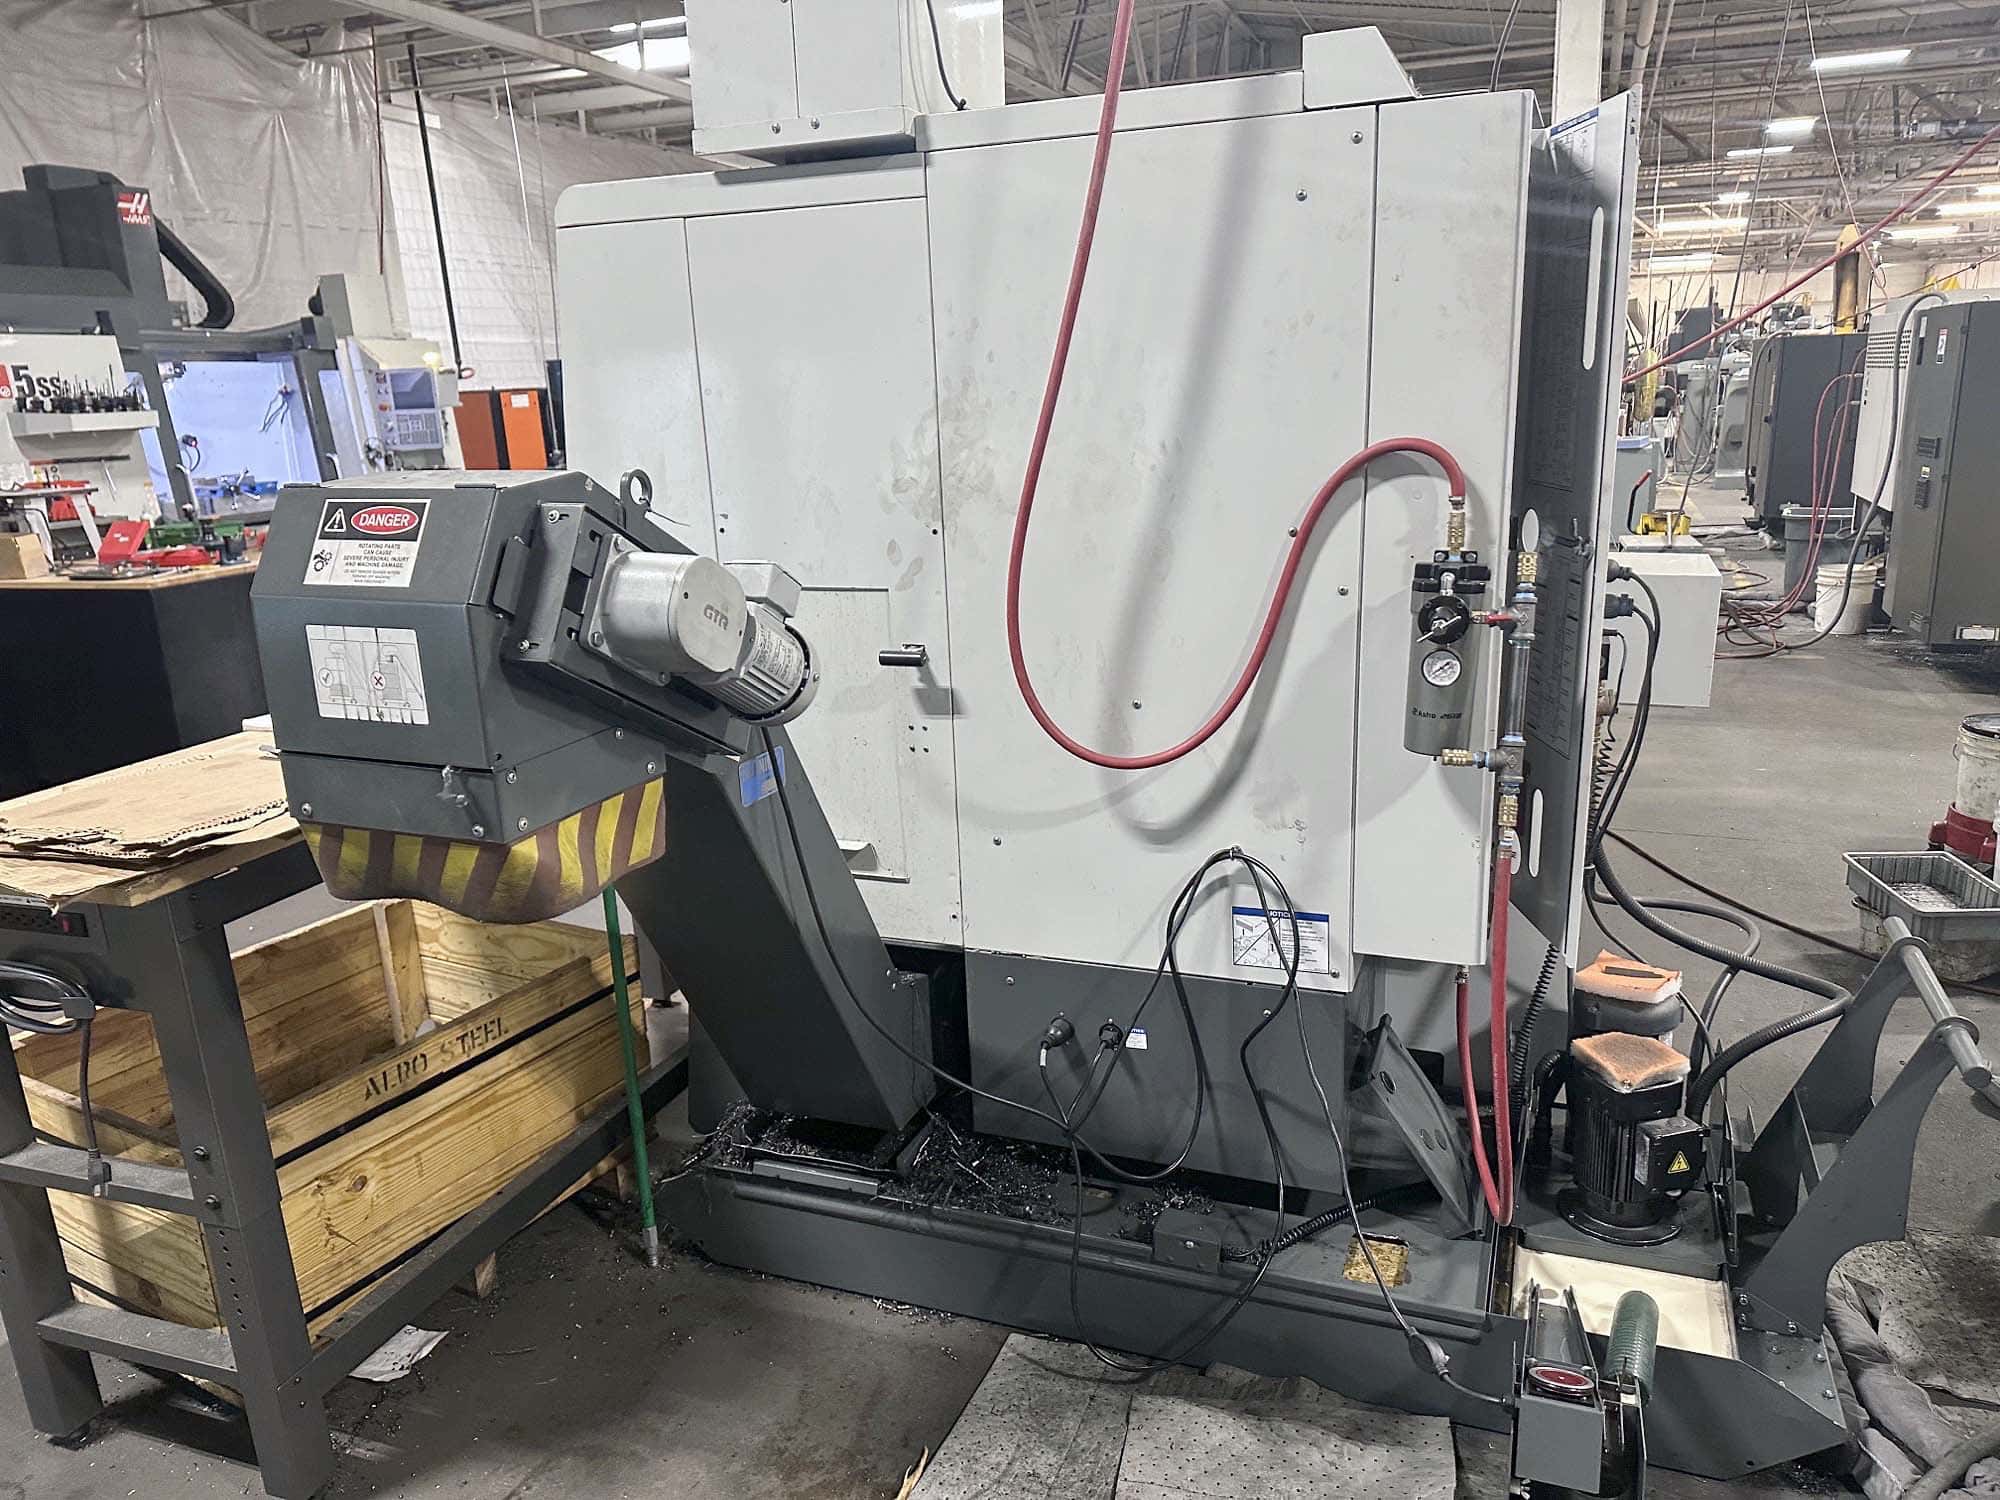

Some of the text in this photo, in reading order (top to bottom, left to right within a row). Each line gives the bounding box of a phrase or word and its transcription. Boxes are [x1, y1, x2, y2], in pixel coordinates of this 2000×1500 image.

[359, 513, 410, 527] DANGER
[703, 604, 729, 631] GTR
[440, 1017, 509, 1063] STEEL
